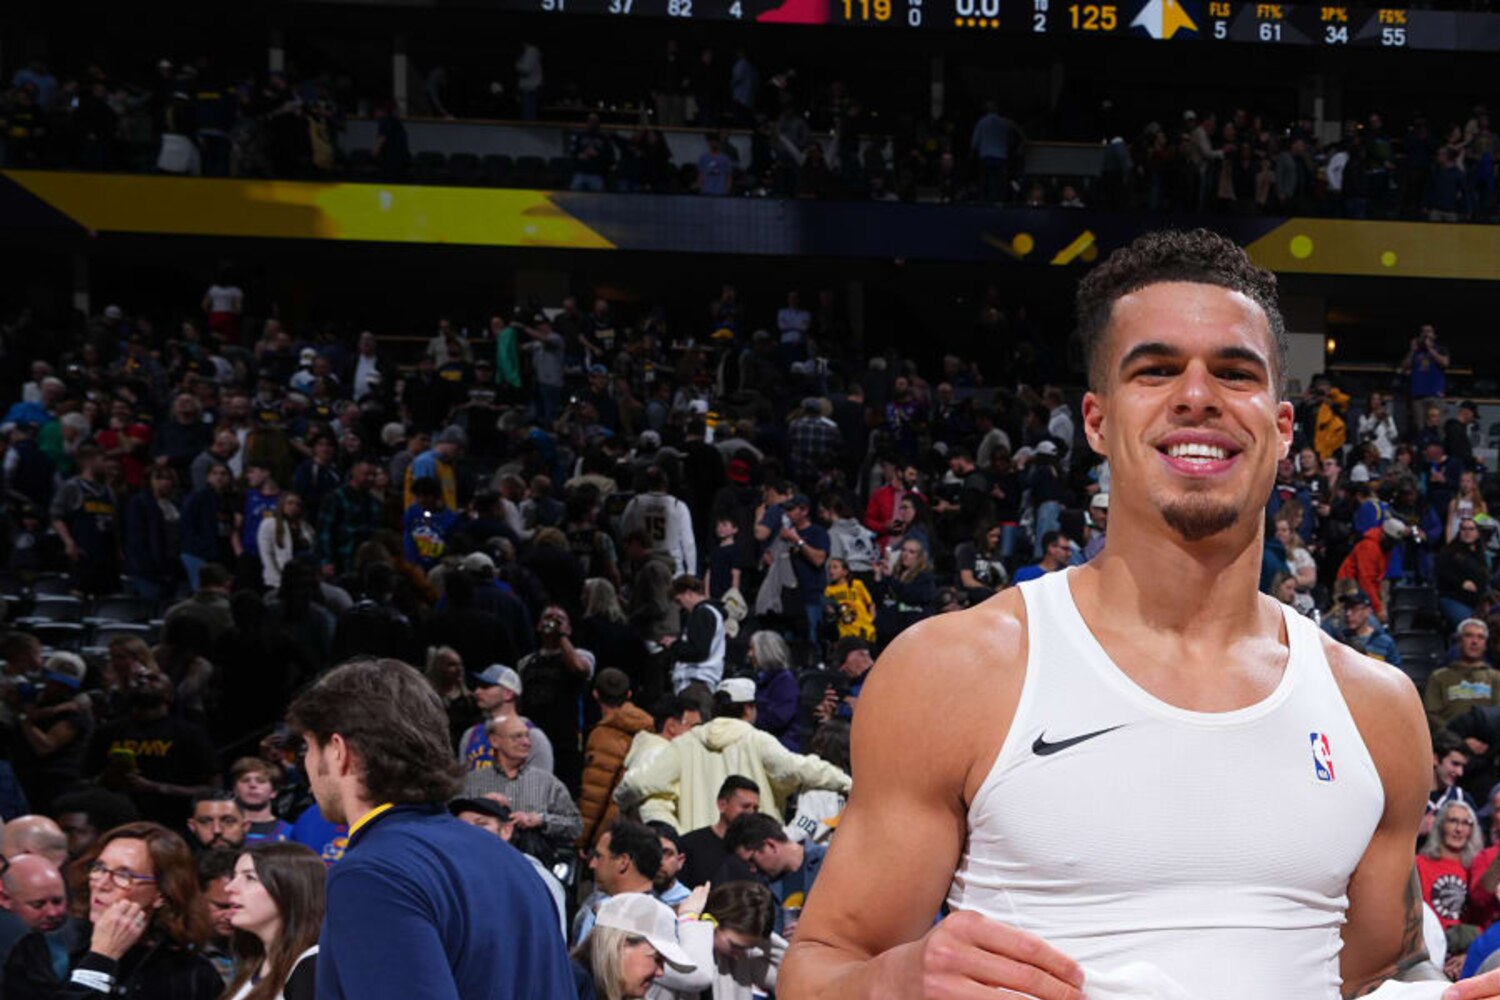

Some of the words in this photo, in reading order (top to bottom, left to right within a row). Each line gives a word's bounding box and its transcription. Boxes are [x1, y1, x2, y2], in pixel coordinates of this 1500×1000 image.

[667, 0, 692, 17] 82
[728, 0, 742, 19] 4
[841, 0, 892, 22] 119
[907, 8, 922, 27] 0
[1068, 4, 1118, 31] 125
[1209, 3, 1231, 17] FLS
[1256, 4, 1283, 19] FT%
[1320, 6, 1349, 22] 3P%
[1378, 9, 1407, 24] FG%
[1032, 14, 1047, 33] 2
[1213, 21, 1227, 39] 5
[1259, 23, 1281, 41] 61
[1325, 26, 1349, 45] 34
[1381, 28, 1406, 46] 55
